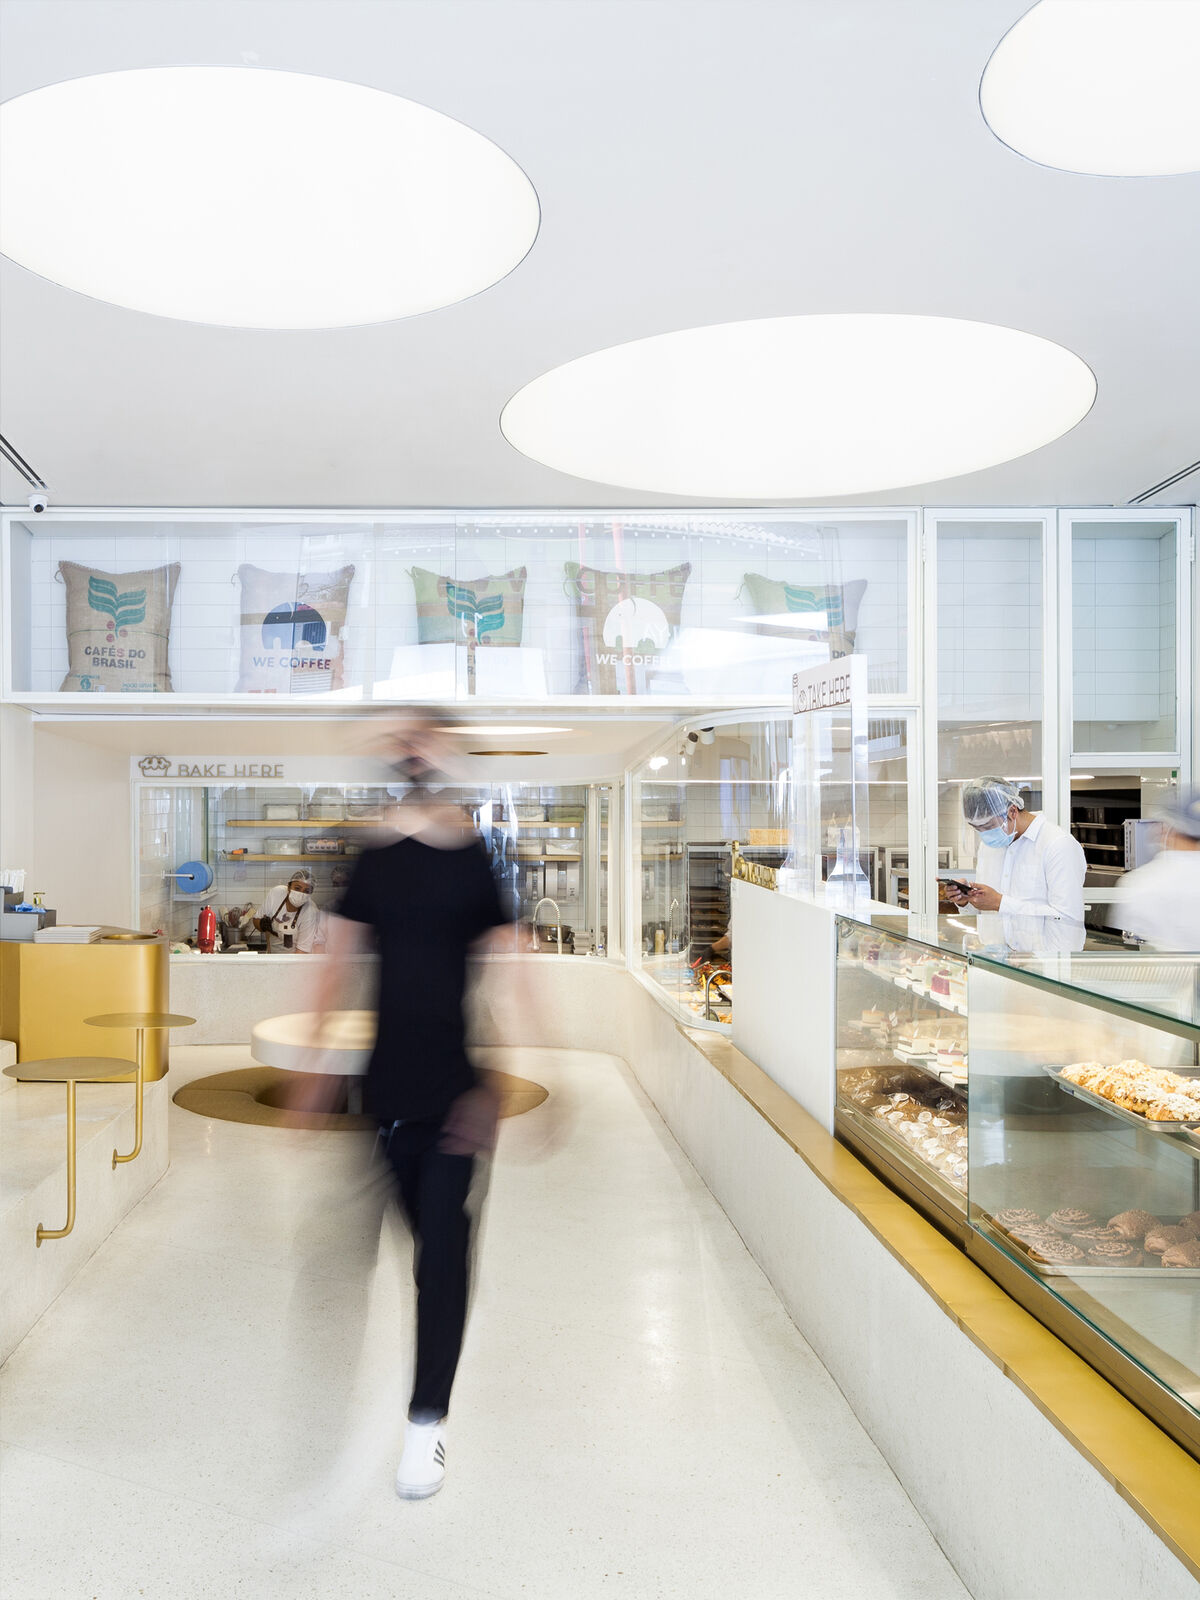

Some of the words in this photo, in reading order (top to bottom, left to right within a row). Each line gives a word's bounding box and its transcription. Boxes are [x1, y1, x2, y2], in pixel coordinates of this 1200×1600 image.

[84, 644, 125, 658] CAFÉS
[128, 649, 146, 659] DO
[92, 657, 136, 669] BRASIL
[253, 656, 274, 667] WE
[280, 656, 331, 670] COFFEE
[596, 654, 618, 666] WE
[808, 680, 827, 710] TAKE
[829, 674, 850, 707] HERE
[178, 764, 227, 777] BAKE
[234, 764, 284, 778] HERE
